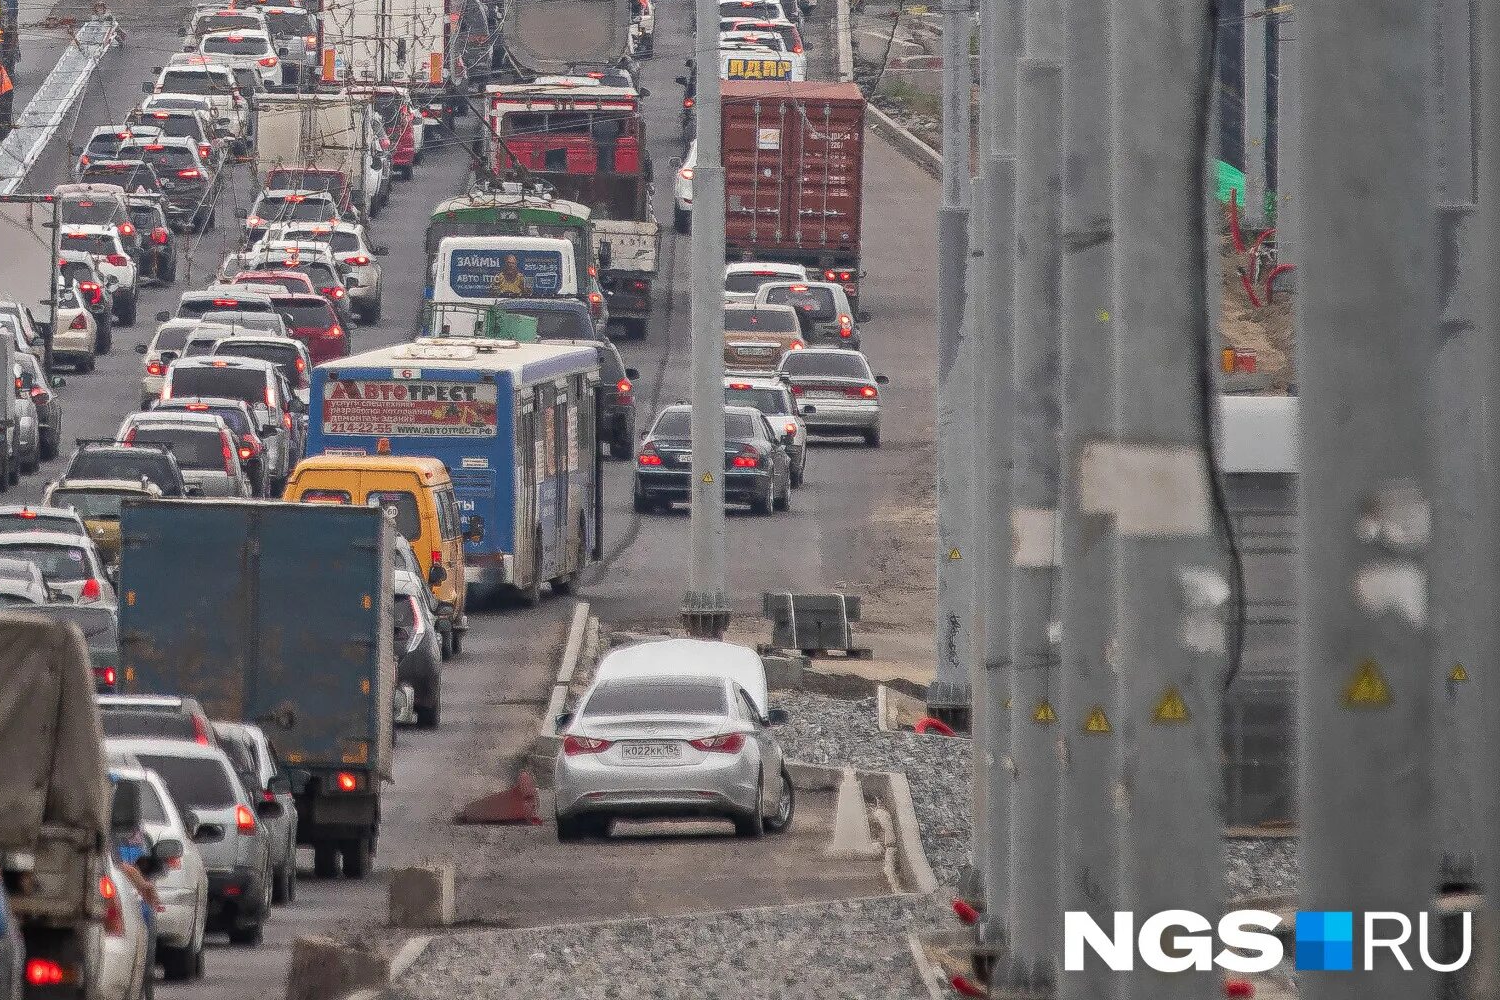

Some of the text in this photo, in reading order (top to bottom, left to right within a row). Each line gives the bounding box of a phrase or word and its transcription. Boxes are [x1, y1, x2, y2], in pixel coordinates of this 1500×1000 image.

[729, 59, 791, 78] ЛДПР
[456, 254, 500, 268] ЗАЙМЫ
[457, 274, 480, 283] АВТО
[402, 369, 413, 379] 6
[361, 401, 415, 409] спецтехники
[330, 415, 379, 423] демонтаж
[330, 423, 393, 433] 214-22-55
[387, 508, 397, 516] 60
